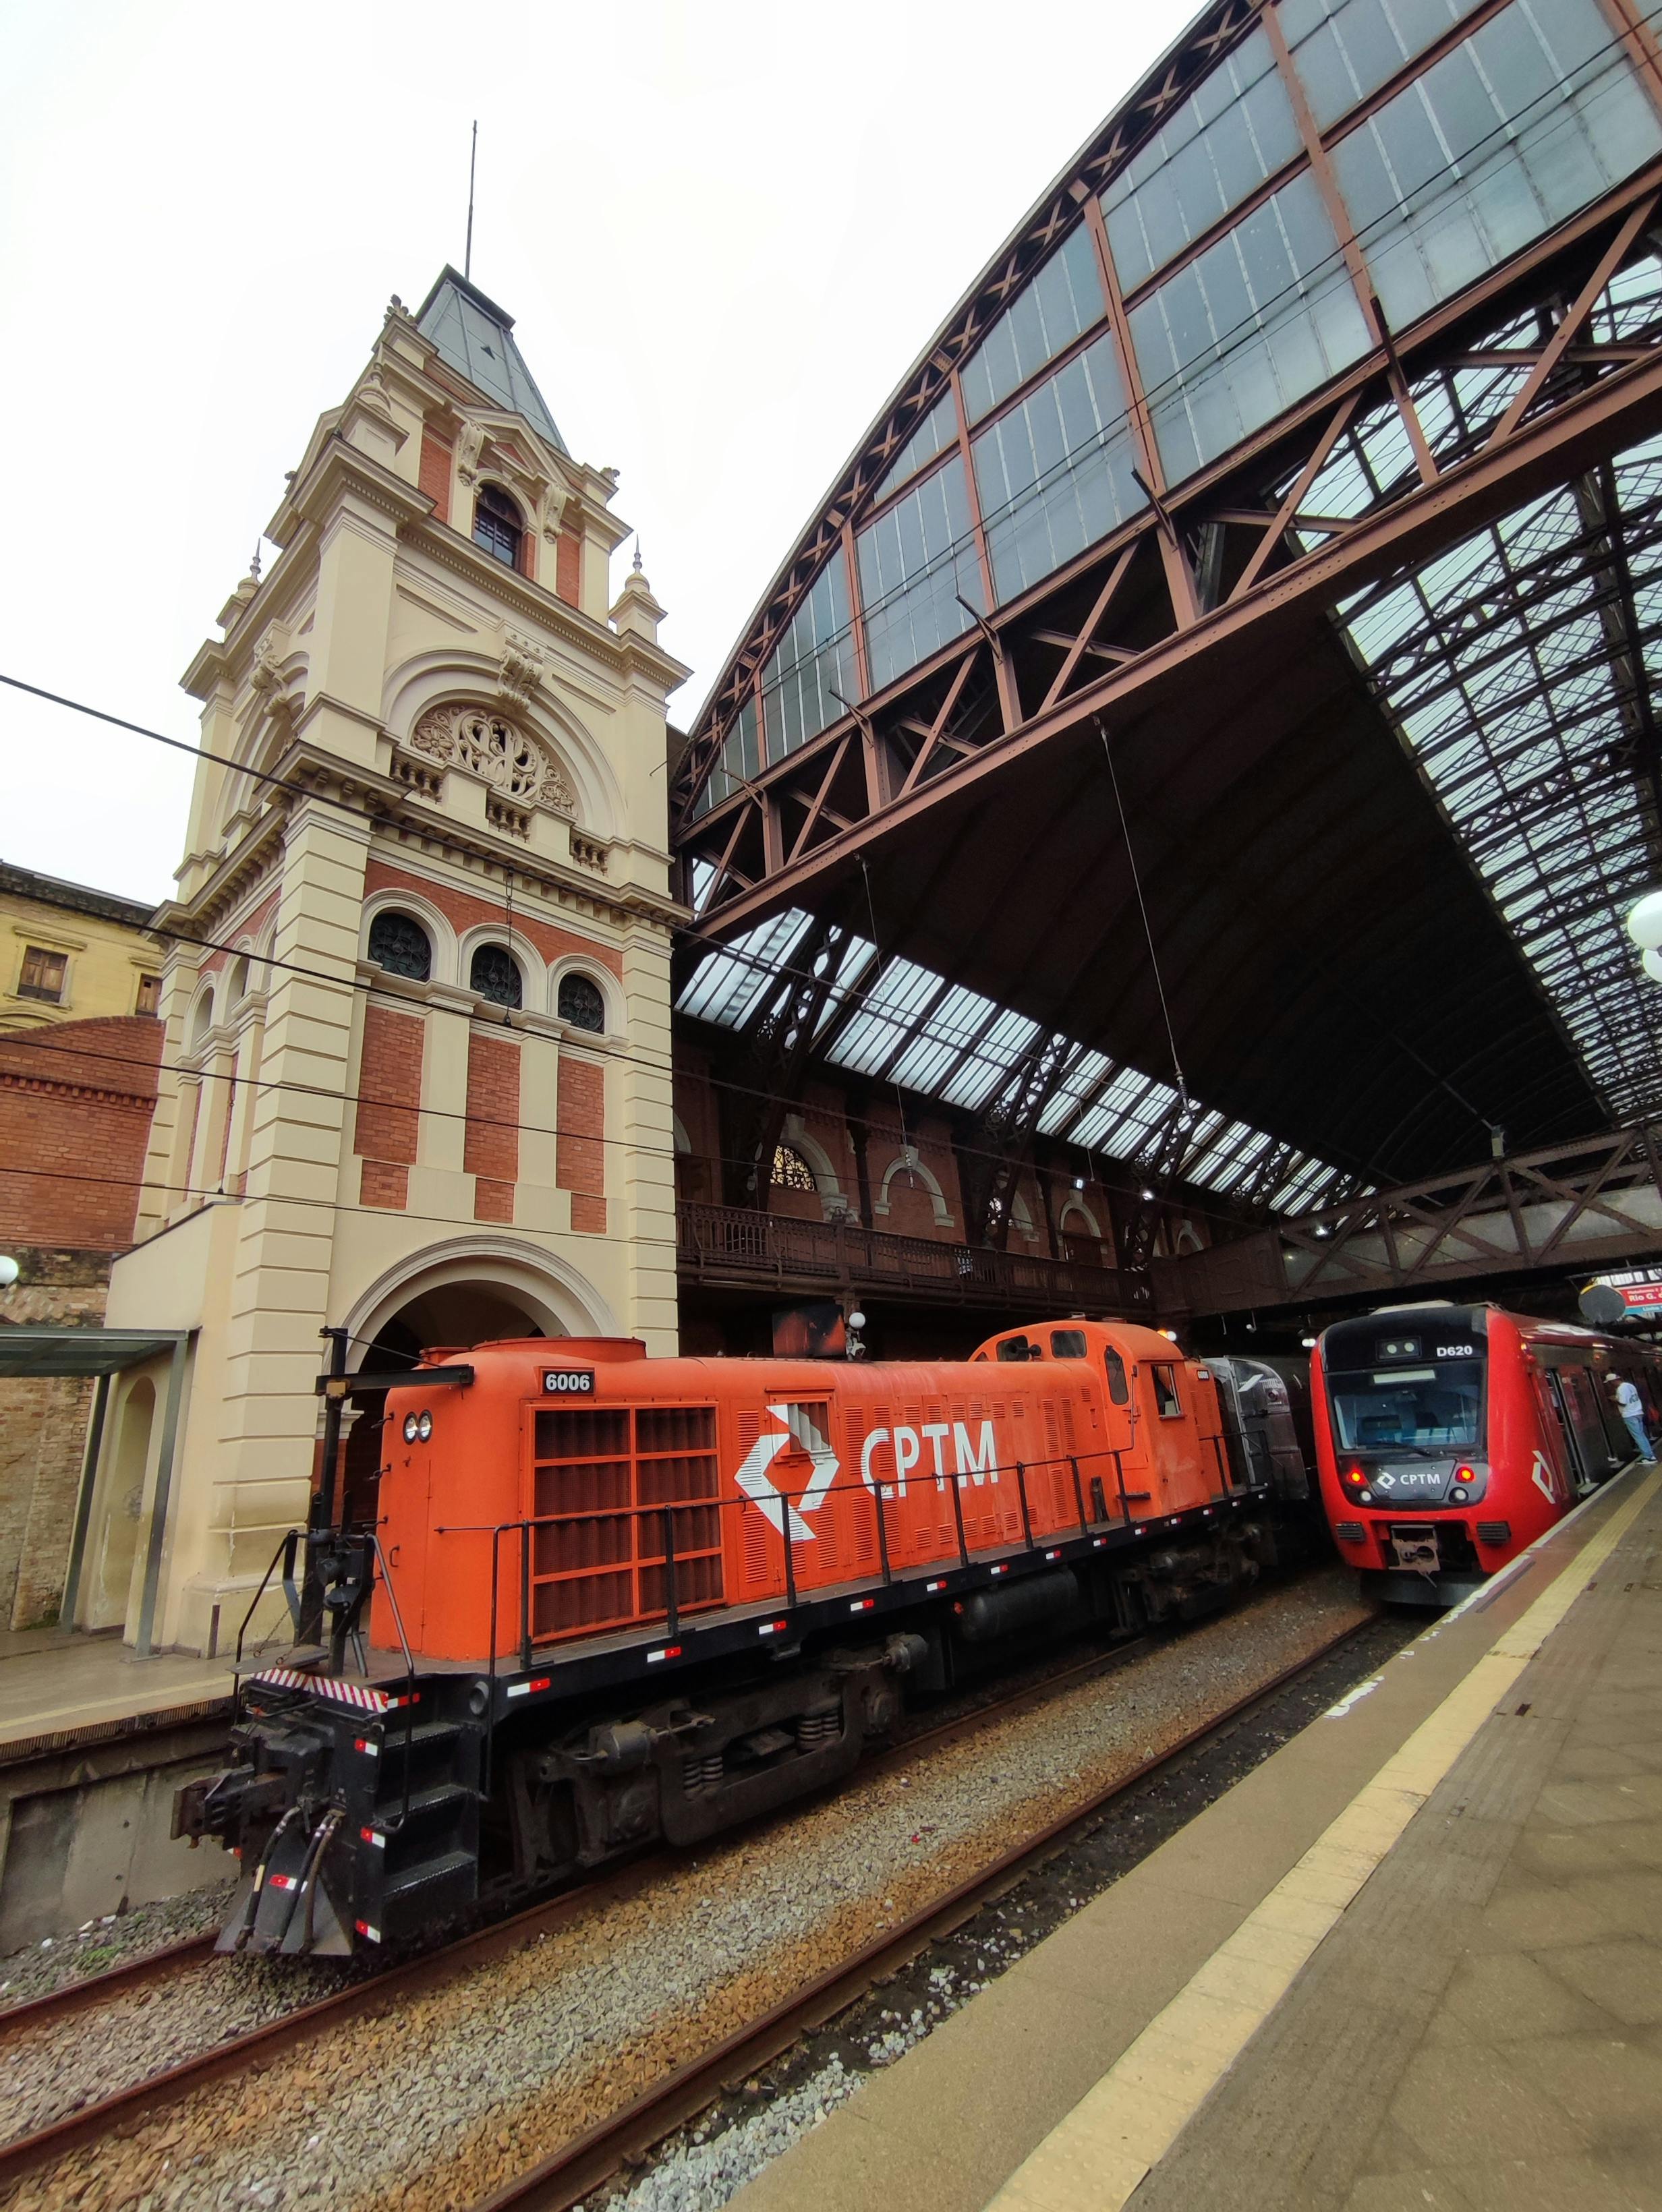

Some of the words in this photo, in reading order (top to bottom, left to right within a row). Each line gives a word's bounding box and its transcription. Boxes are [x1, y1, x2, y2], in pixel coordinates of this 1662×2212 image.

[1437, 1345, 1472, 1357] D620
[546, 1374, 590, 1391] 6006
[861, 1420, 998, 1499] CPTM
[1400, 1474, 1441, 1485] CPTM
